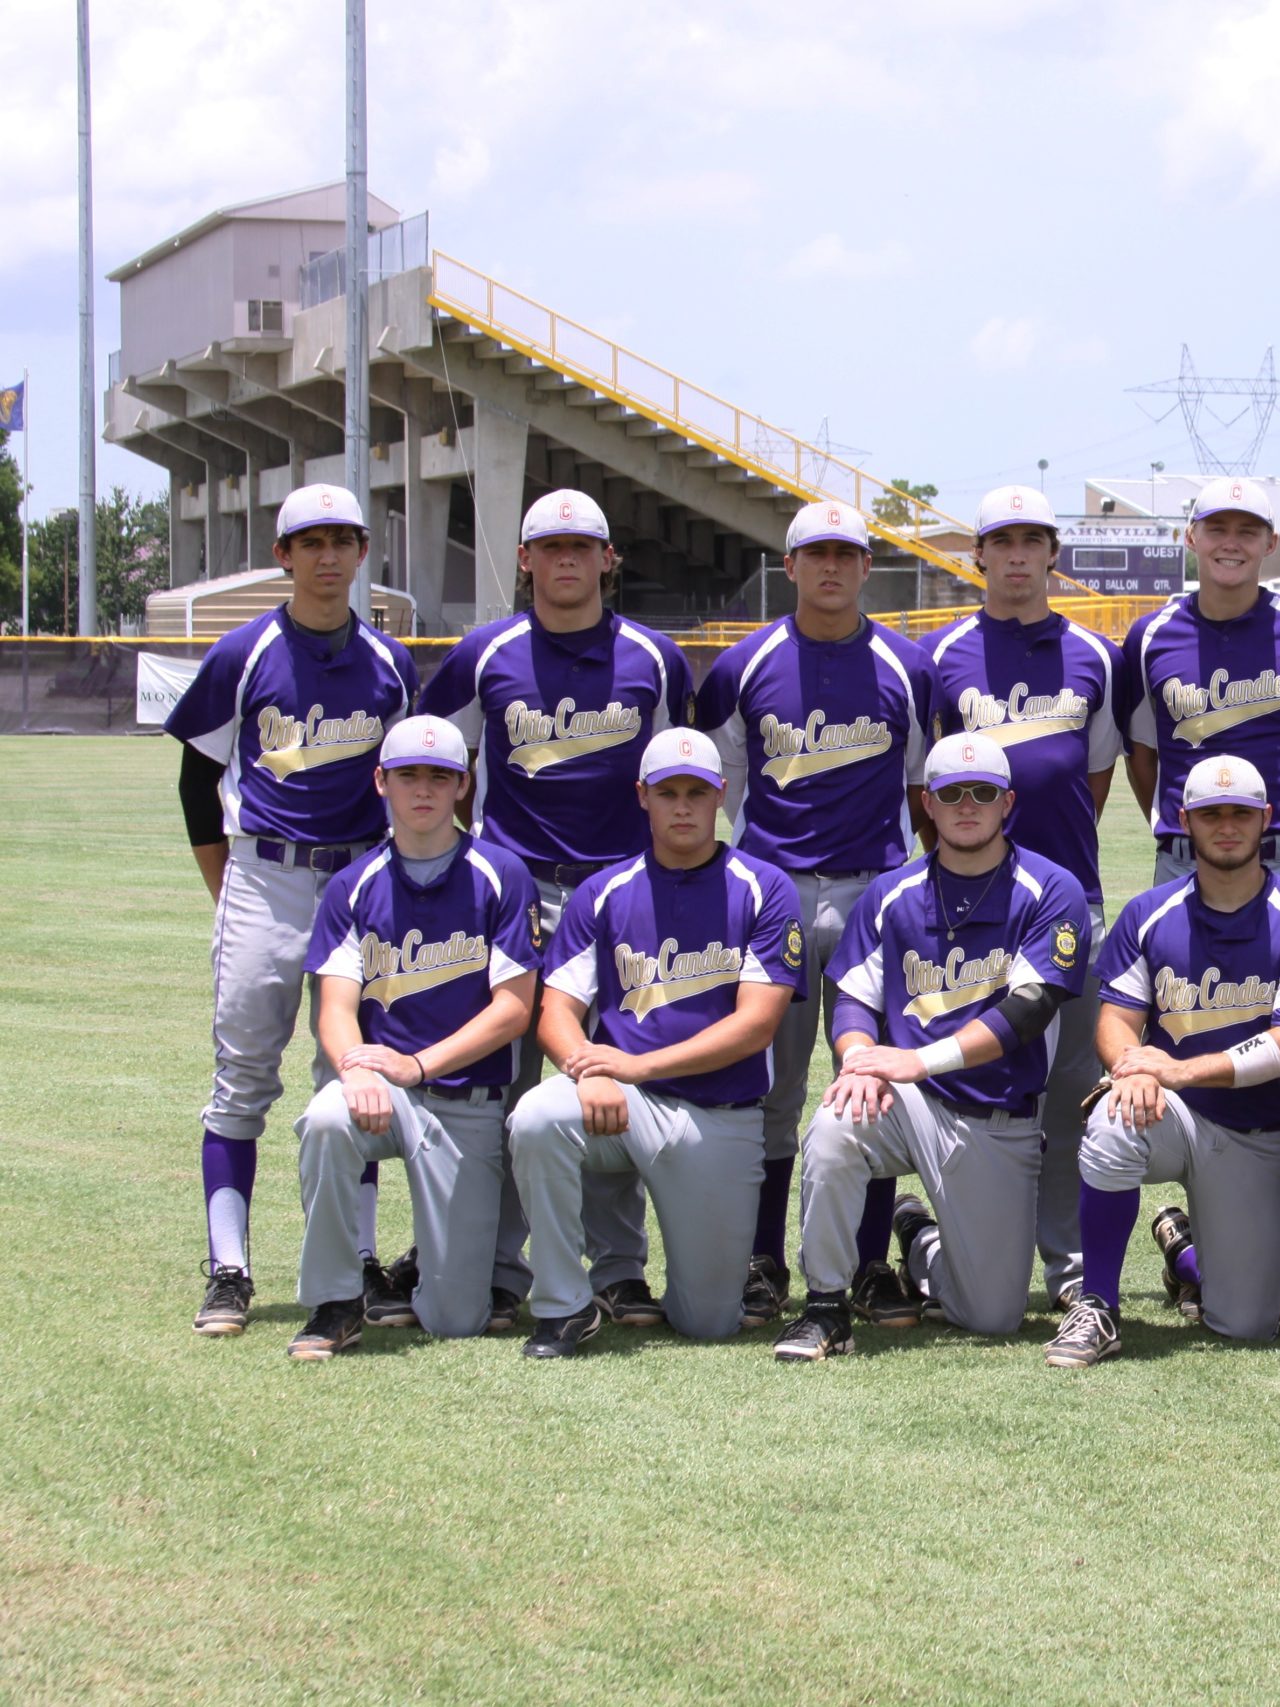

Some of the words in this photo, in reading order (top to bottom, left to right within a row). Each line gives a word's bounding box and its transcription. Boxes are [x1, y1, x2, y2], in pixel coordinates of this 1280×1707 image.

[1230, 483, 1242, 500] C
[320, 492, 332, 509] C
[1010, 494, 1022, 511] C
[560, 503, 572, 519] C
[828, 509, 840, 525] C
[1143, 547, 1181, 558] GUEST
[1088, 579, 1100, 590] GO
[1105, 579, 1125, 590] BALL
[1126, 579, 1138, 590] ON
[1154, 579, 1171, 590] QTR.
[1163, 678, 1209, 722] Otto
[959, 687, 1007, 732] Otto
[505, 700, 554, 746] Otto
[555, 697, 641, 739] Candies
[423, 730, 435, 746] C
[760, 714, 805, 757] Otto
[805, 709, 891, 753] Candies
[679, 740, 691, 756] C
[962, 745, 974, 762] C
[401, 929, 488, 972] Candies
[614, 943, 658, 990] Otto
[658, 938, 743, 981] Candies
[903, 950, 945, 996] Otto
[1155, 966, 1200, 1011] Otto
[1200, 966, 1277, 1009] Candies
